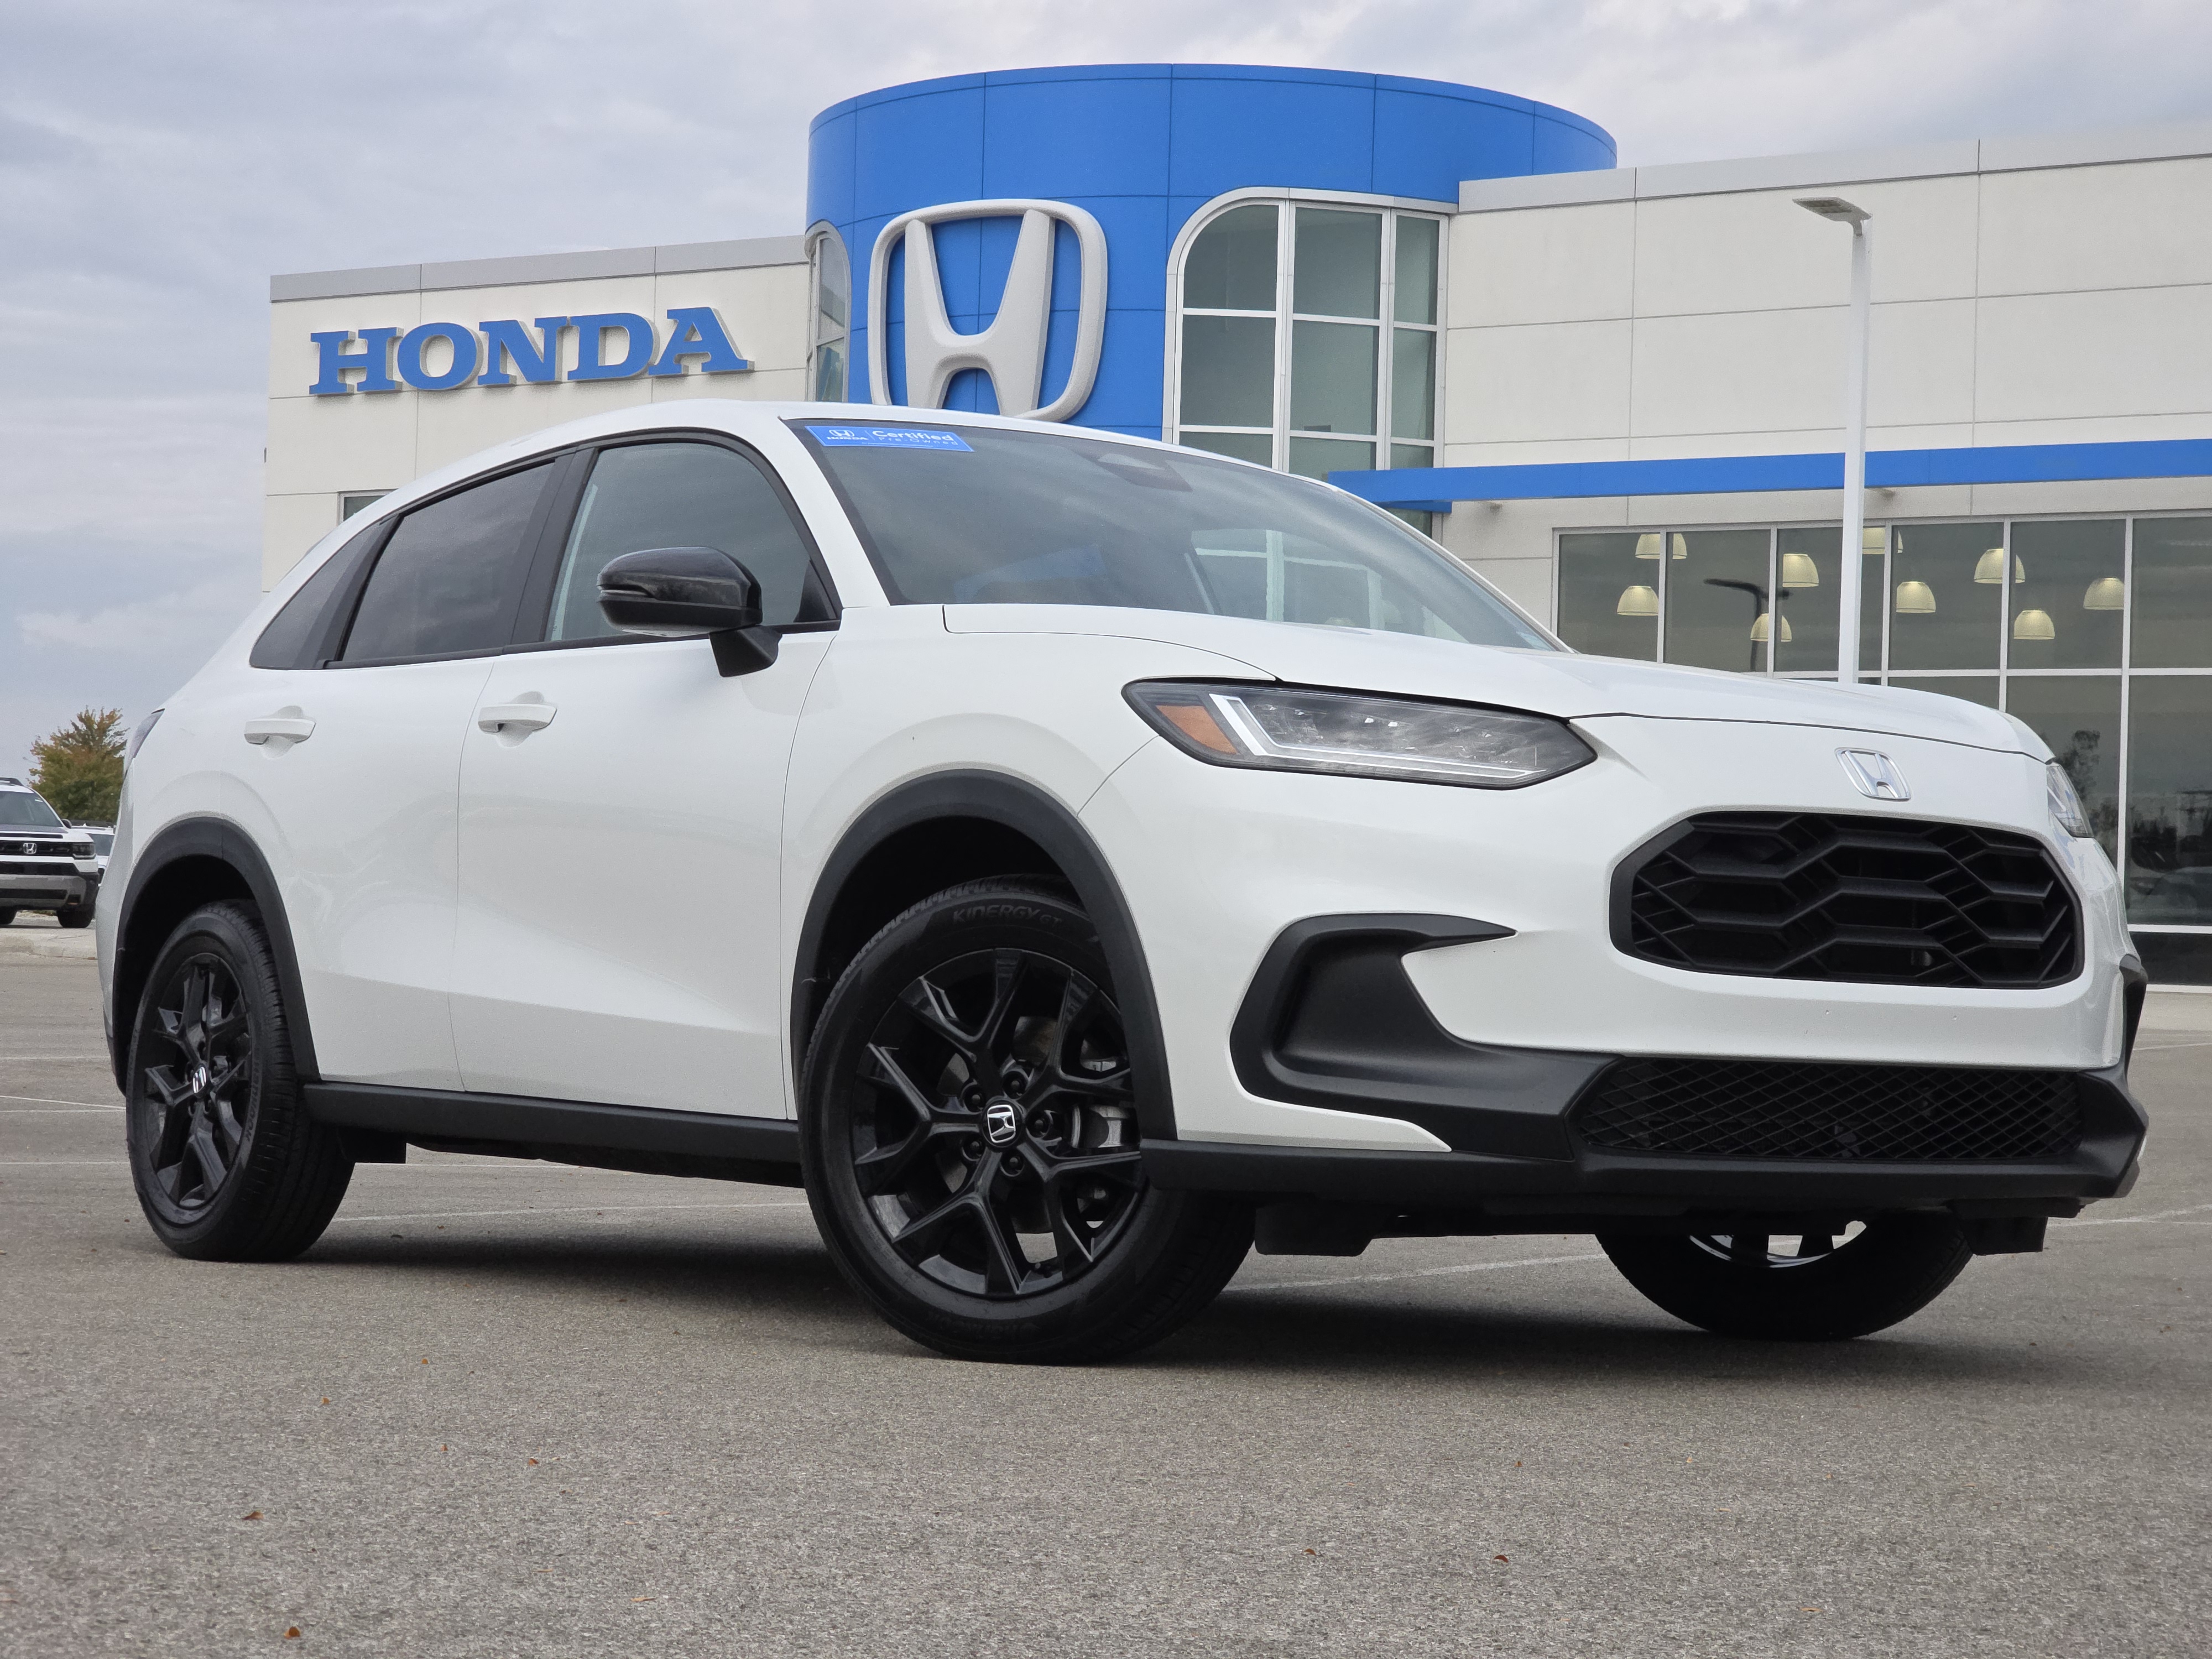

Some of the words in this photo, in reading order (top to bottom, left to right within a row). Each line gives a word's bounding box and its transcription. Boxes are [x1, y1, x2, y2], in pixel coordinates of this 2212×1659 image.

[309, 306, 755, 396] HONDA
[872, 430, 954, 441] Certified
[952, 904, 1041, 924] KINERGY
